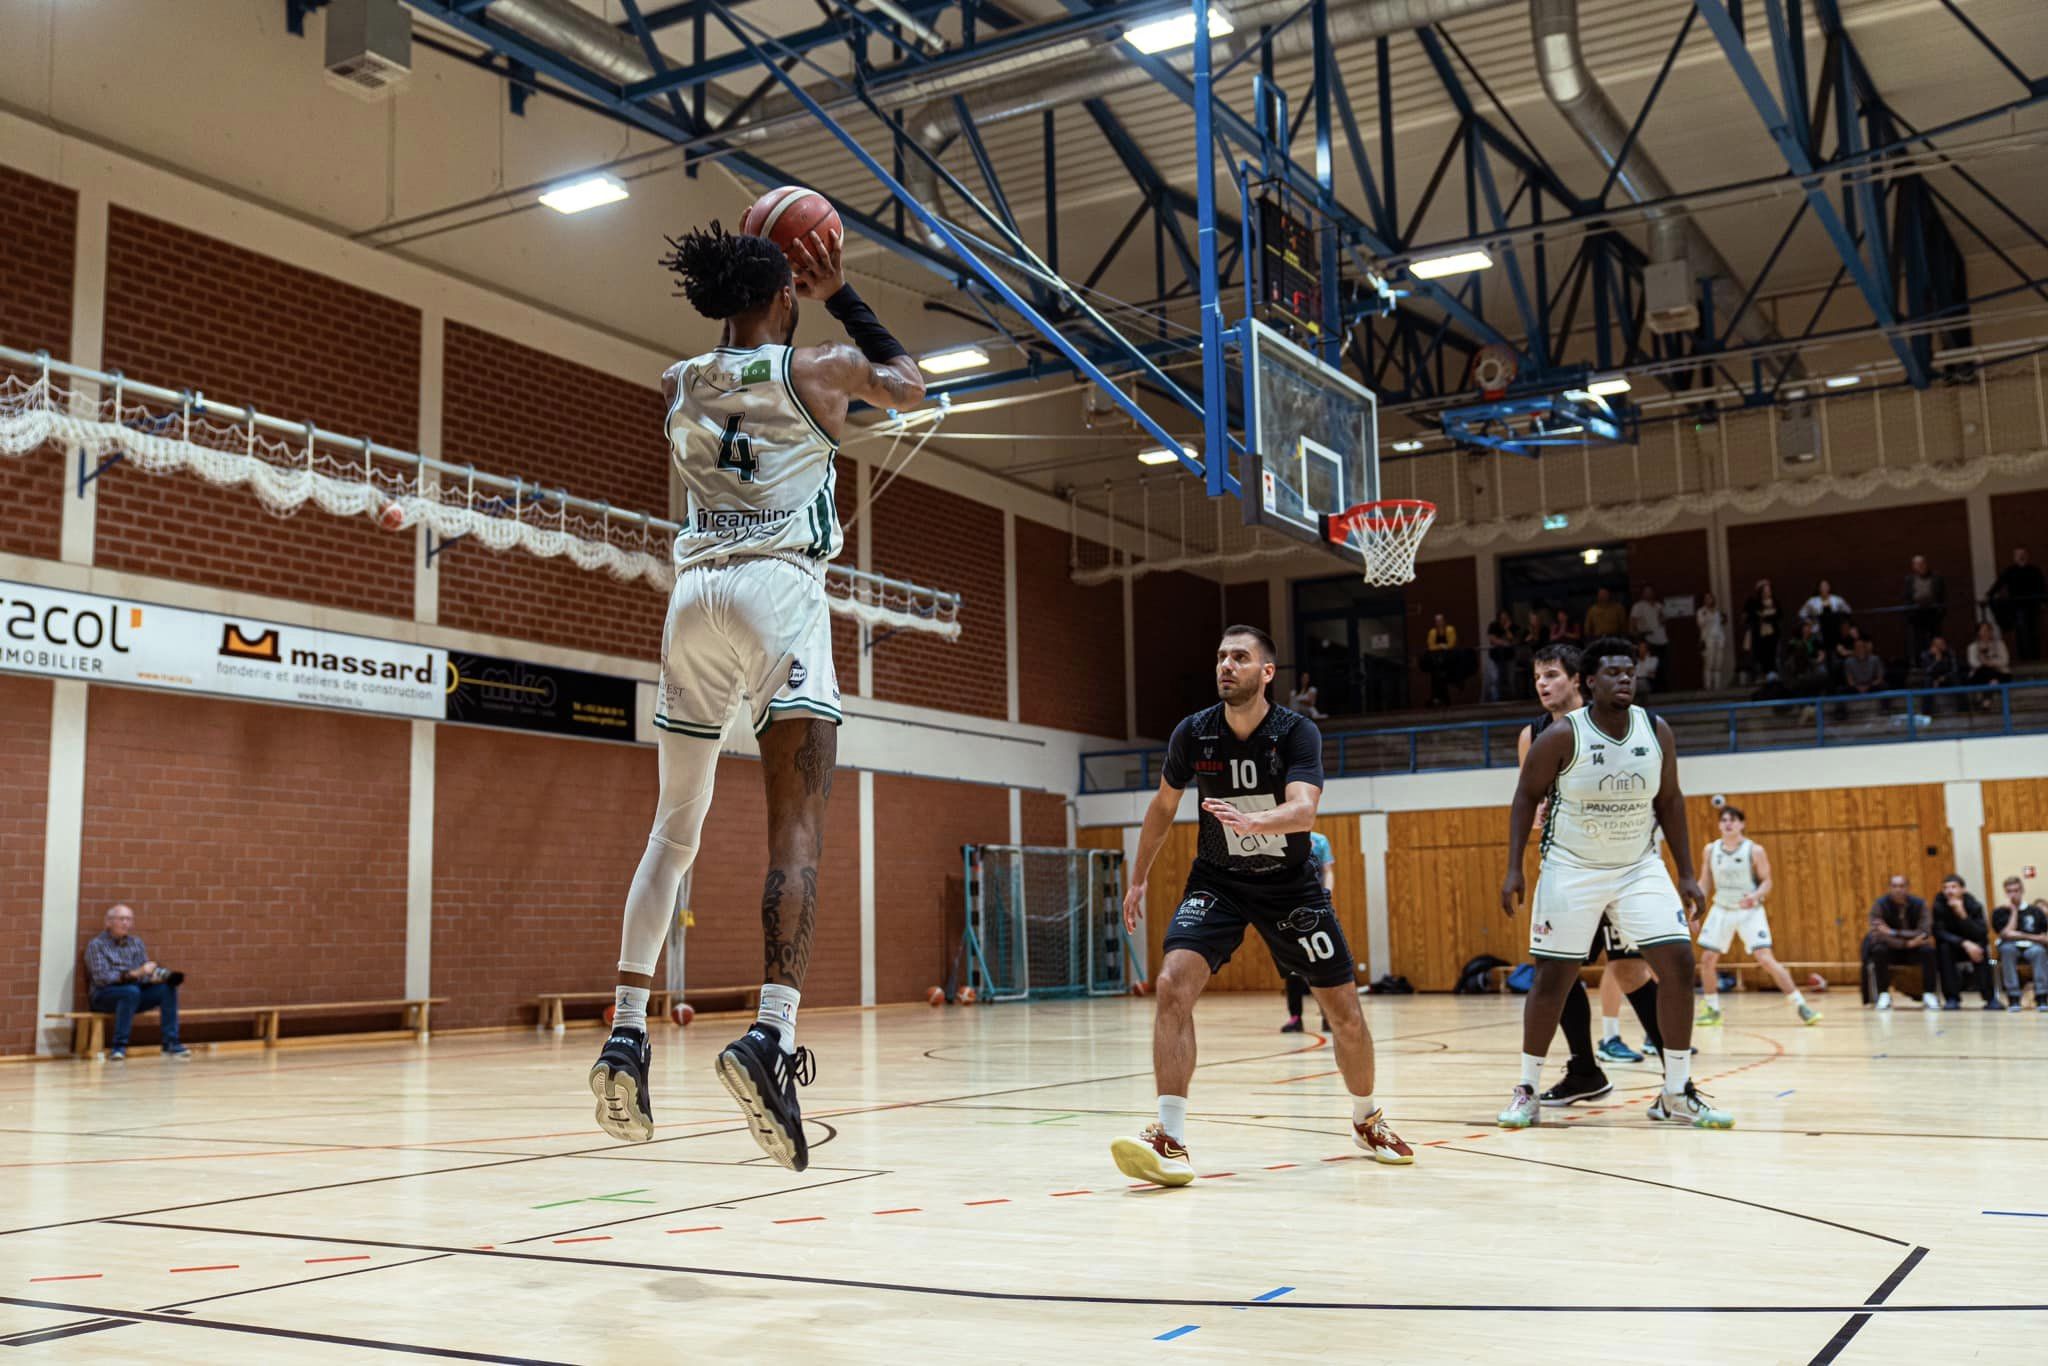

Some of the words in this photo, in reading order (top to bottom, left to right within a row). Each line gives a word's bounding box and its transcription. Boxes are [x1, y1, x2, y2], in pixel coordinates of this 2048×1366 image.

[715, 412, 759, 483] 4
[0, 648, 103, 672] MOBILIER
[291, 649, 433, 684] massard
[216, 660, 272, 681] fonderie
[276, 669, 289, 683] et
[343, 678, 358, 690] de
[361, 683, 433, 701] construction
[1230, 759, 1258, 790] 10
[1592, 751, 1605, 766] 14
[1297, 931, 1335, 963] 10
